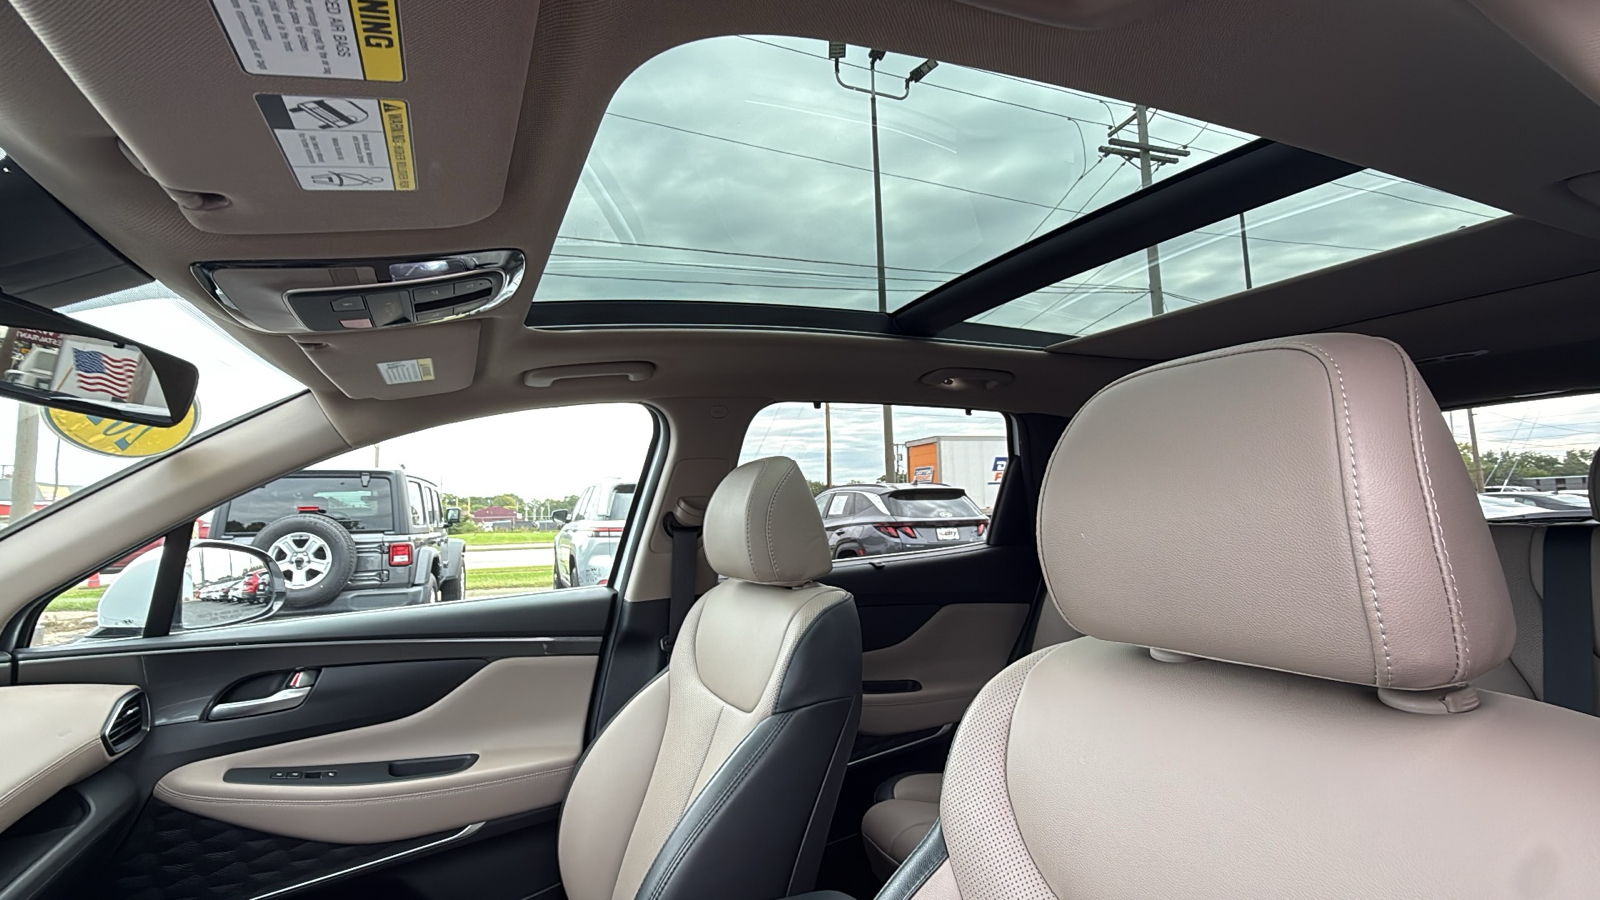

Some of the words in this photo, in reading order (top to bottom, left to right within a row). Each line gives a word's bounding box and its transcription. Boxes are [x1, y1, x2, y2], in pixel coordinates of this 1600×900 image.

[328, 16, 345, 32] AIR
[357, 0, 394, 49] NING
[333, 34, 351, 57] BAGS
